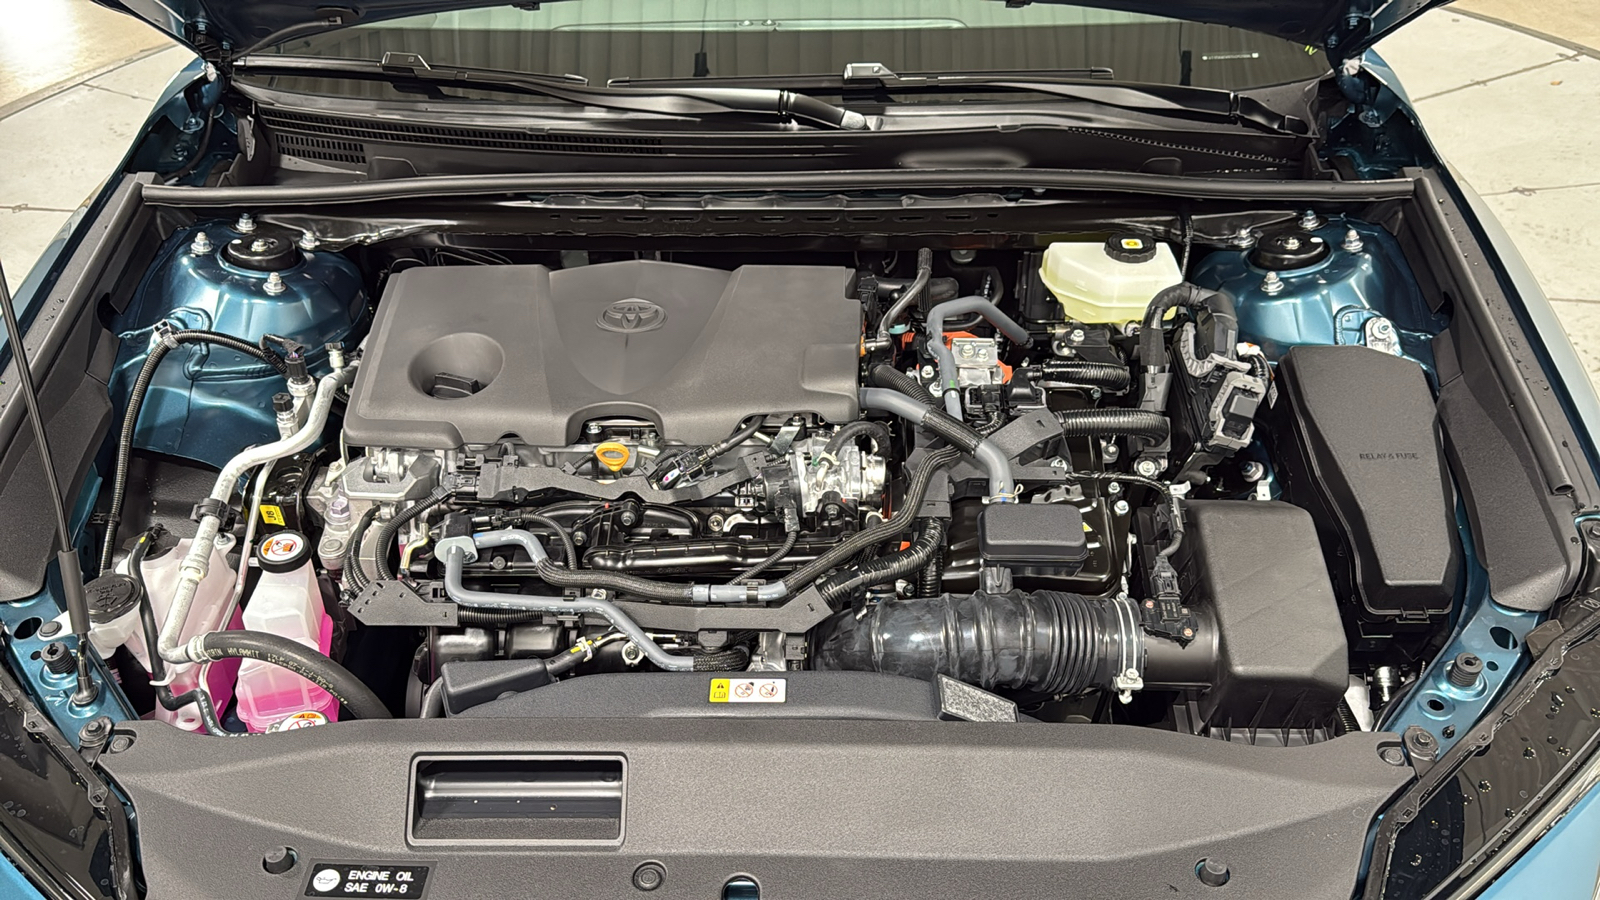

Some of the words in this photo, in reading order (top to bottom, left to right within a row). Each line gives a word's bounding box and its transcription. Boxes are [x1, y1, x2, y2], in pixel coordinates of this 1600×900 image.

[1359, 452, 1386, 460] RELAY
[1395, 452, 1419, 460] FUSE
[348, 870, 390, 880] ENGINE
[396, 871, 414, 881] OIL
[344, 882, 369, 892] SAE
[375, 883, 408, 893] 0W-8
